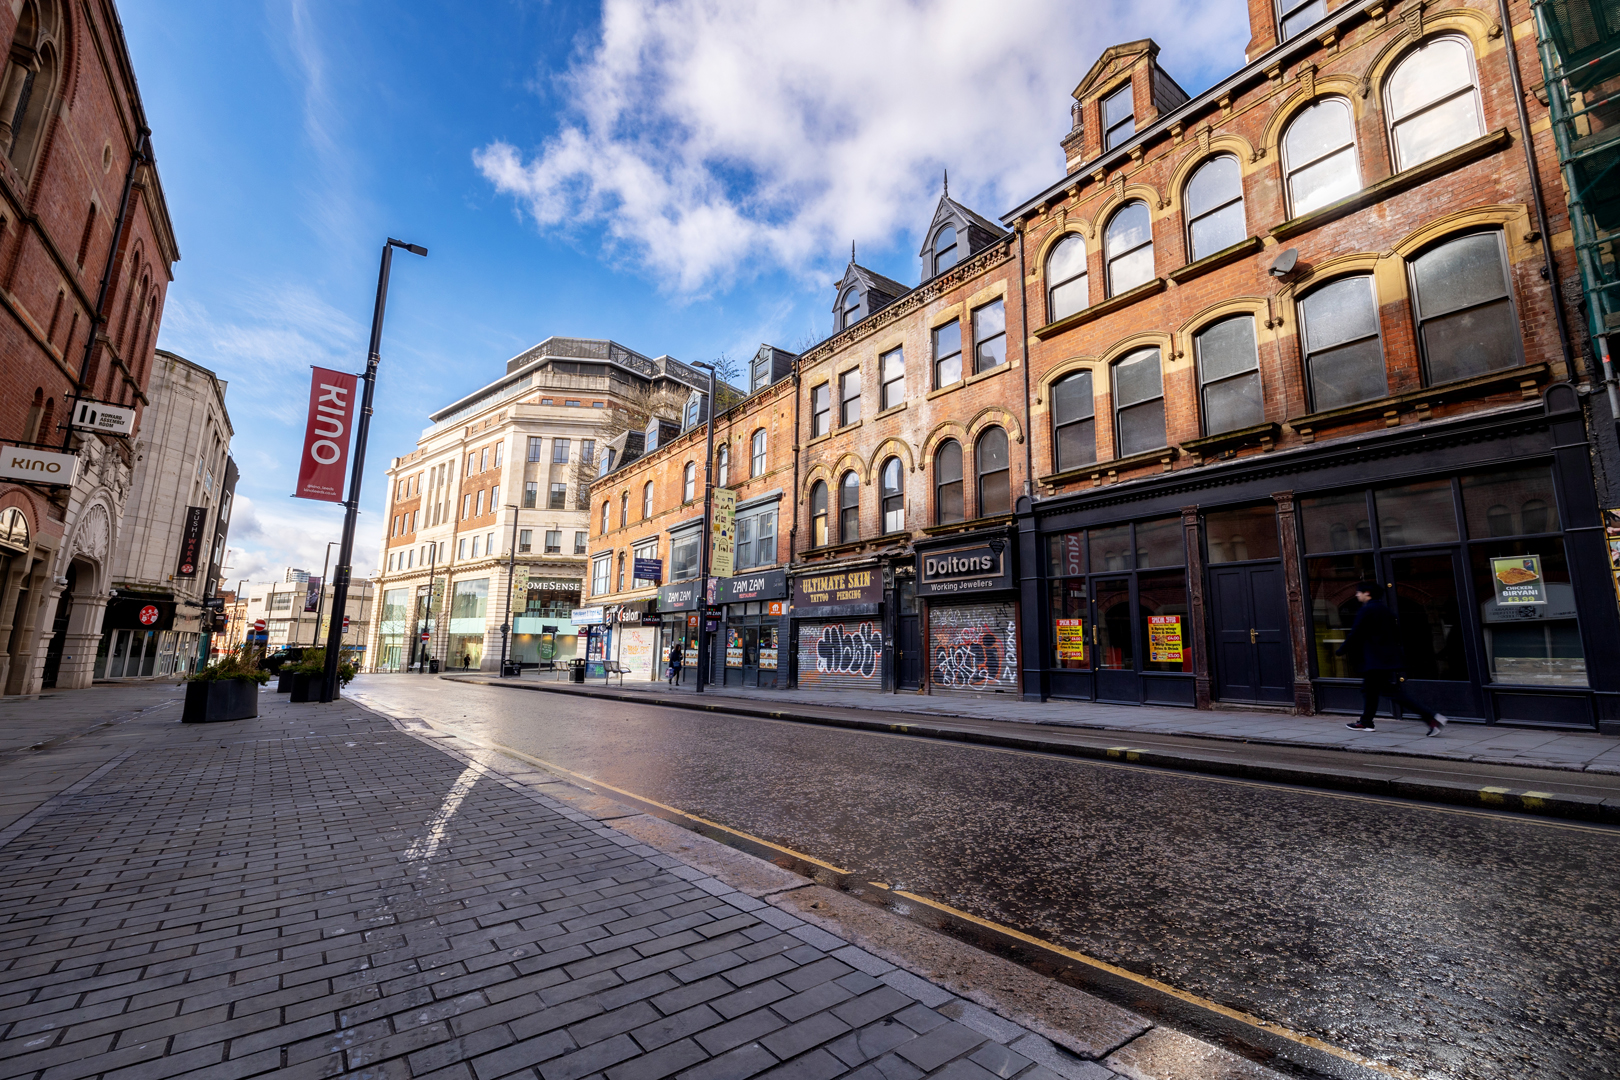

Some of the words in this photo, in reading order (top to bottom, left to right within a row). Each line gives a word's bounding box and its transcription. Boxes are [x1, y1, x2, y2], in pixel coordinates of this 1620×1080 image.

[191, 509, 200, 538] SUSHI
[186, 538, 197, 562] WAKA
[926, 555, 993, 576] Doltons
[527, 582, 580, 591] OMESENSE
[733, 581, 748, 593] ZAM
[749, 578, 765, 591] ZAM
[802, 574, 846, 594] ULTIMATE
[847, 571, 871, 589] SKIN
[931, 583, 958, 591] Working
[959, 580, 993, 589] Jewellers
[668, 592, 679, 602] ZAM
[680, 590, 692, 602] ZAM
[810, 593, 830, 603] TATTOO
[836, 590, 862, 600] PIERCING
[622, 609, 639, 622] salon
